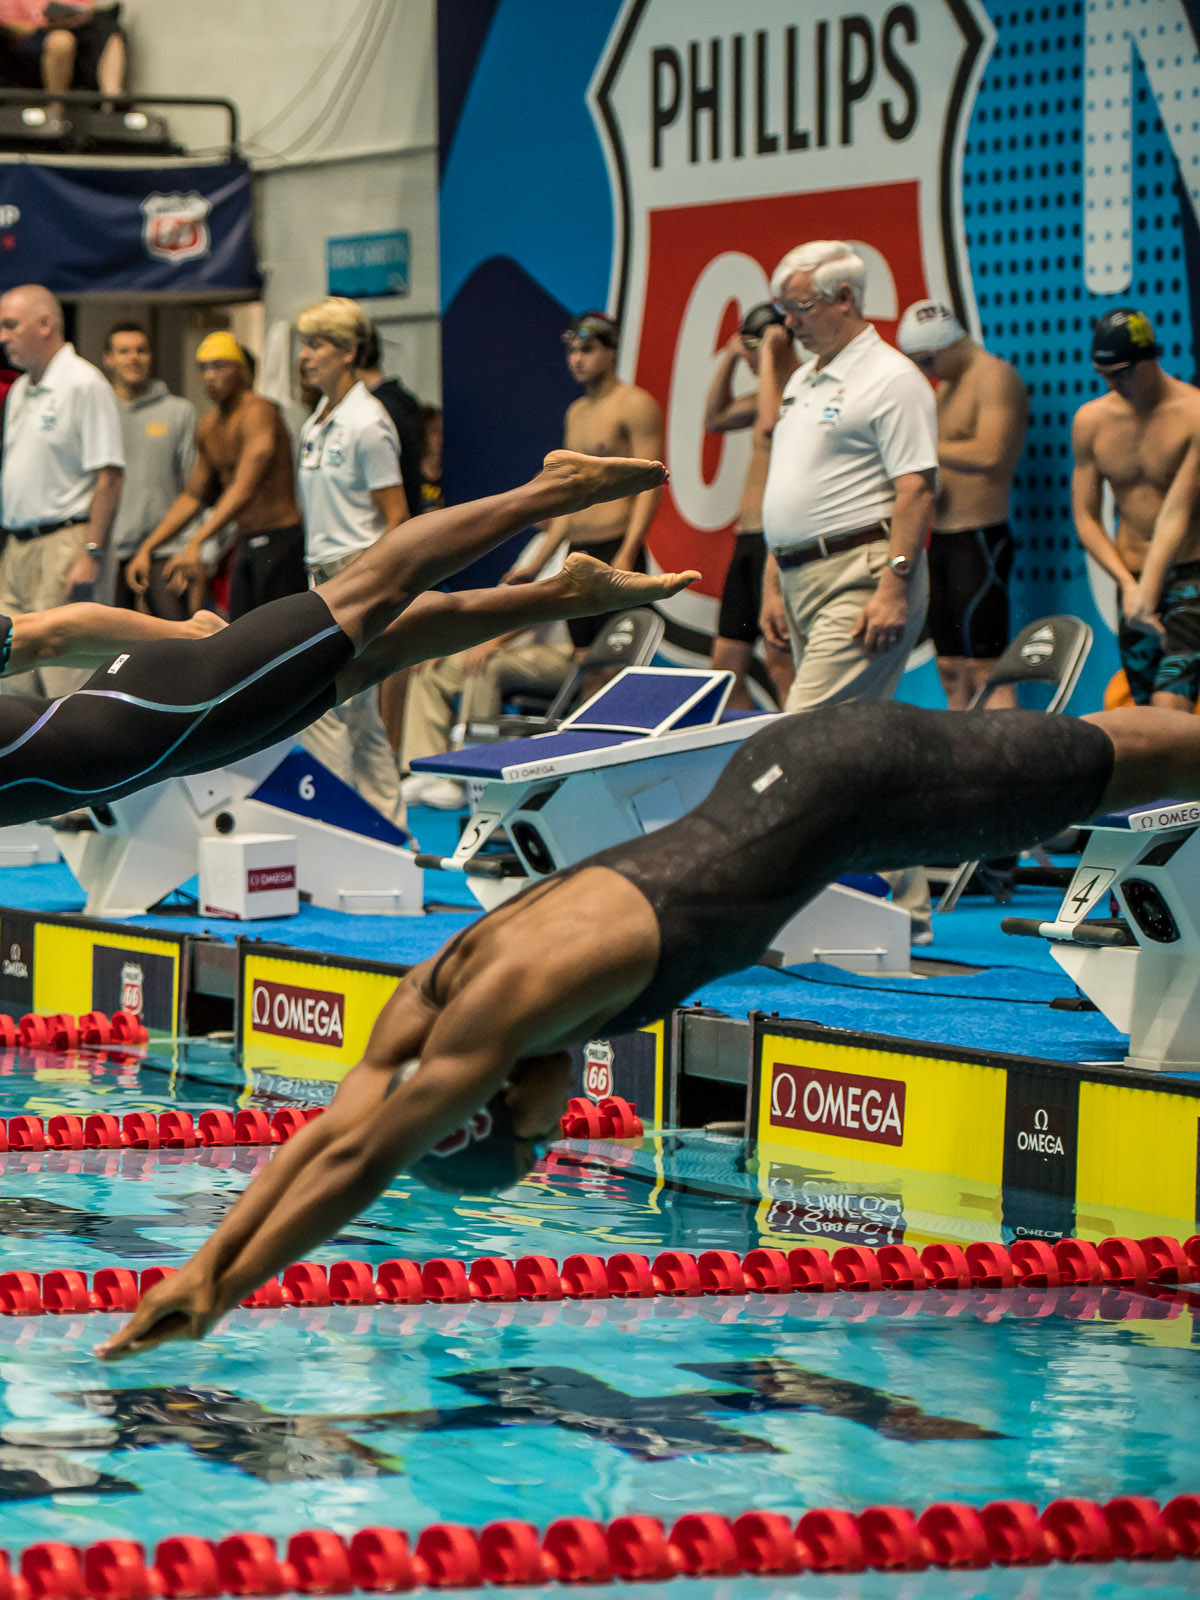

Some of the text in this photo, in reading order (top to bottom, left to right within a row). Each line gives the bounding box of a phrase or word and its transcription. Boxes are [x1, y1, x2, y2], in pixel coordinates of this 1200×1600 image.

[650, 3, 921, 169] PHILLIPS
[521, 765, 555, 777] OMEGA
[299, 774, 315, 800] 6
[461, 819, 490, 850] 5
[1071, 875, 1100, 914] 4
[273, 993, 343, 1040] OMEGA
[588, 1065, 608, 1091] 66
[803, 1080, 902, 1136] OMEGA
[1017, 1131, 1064, 1155] OMEGA
